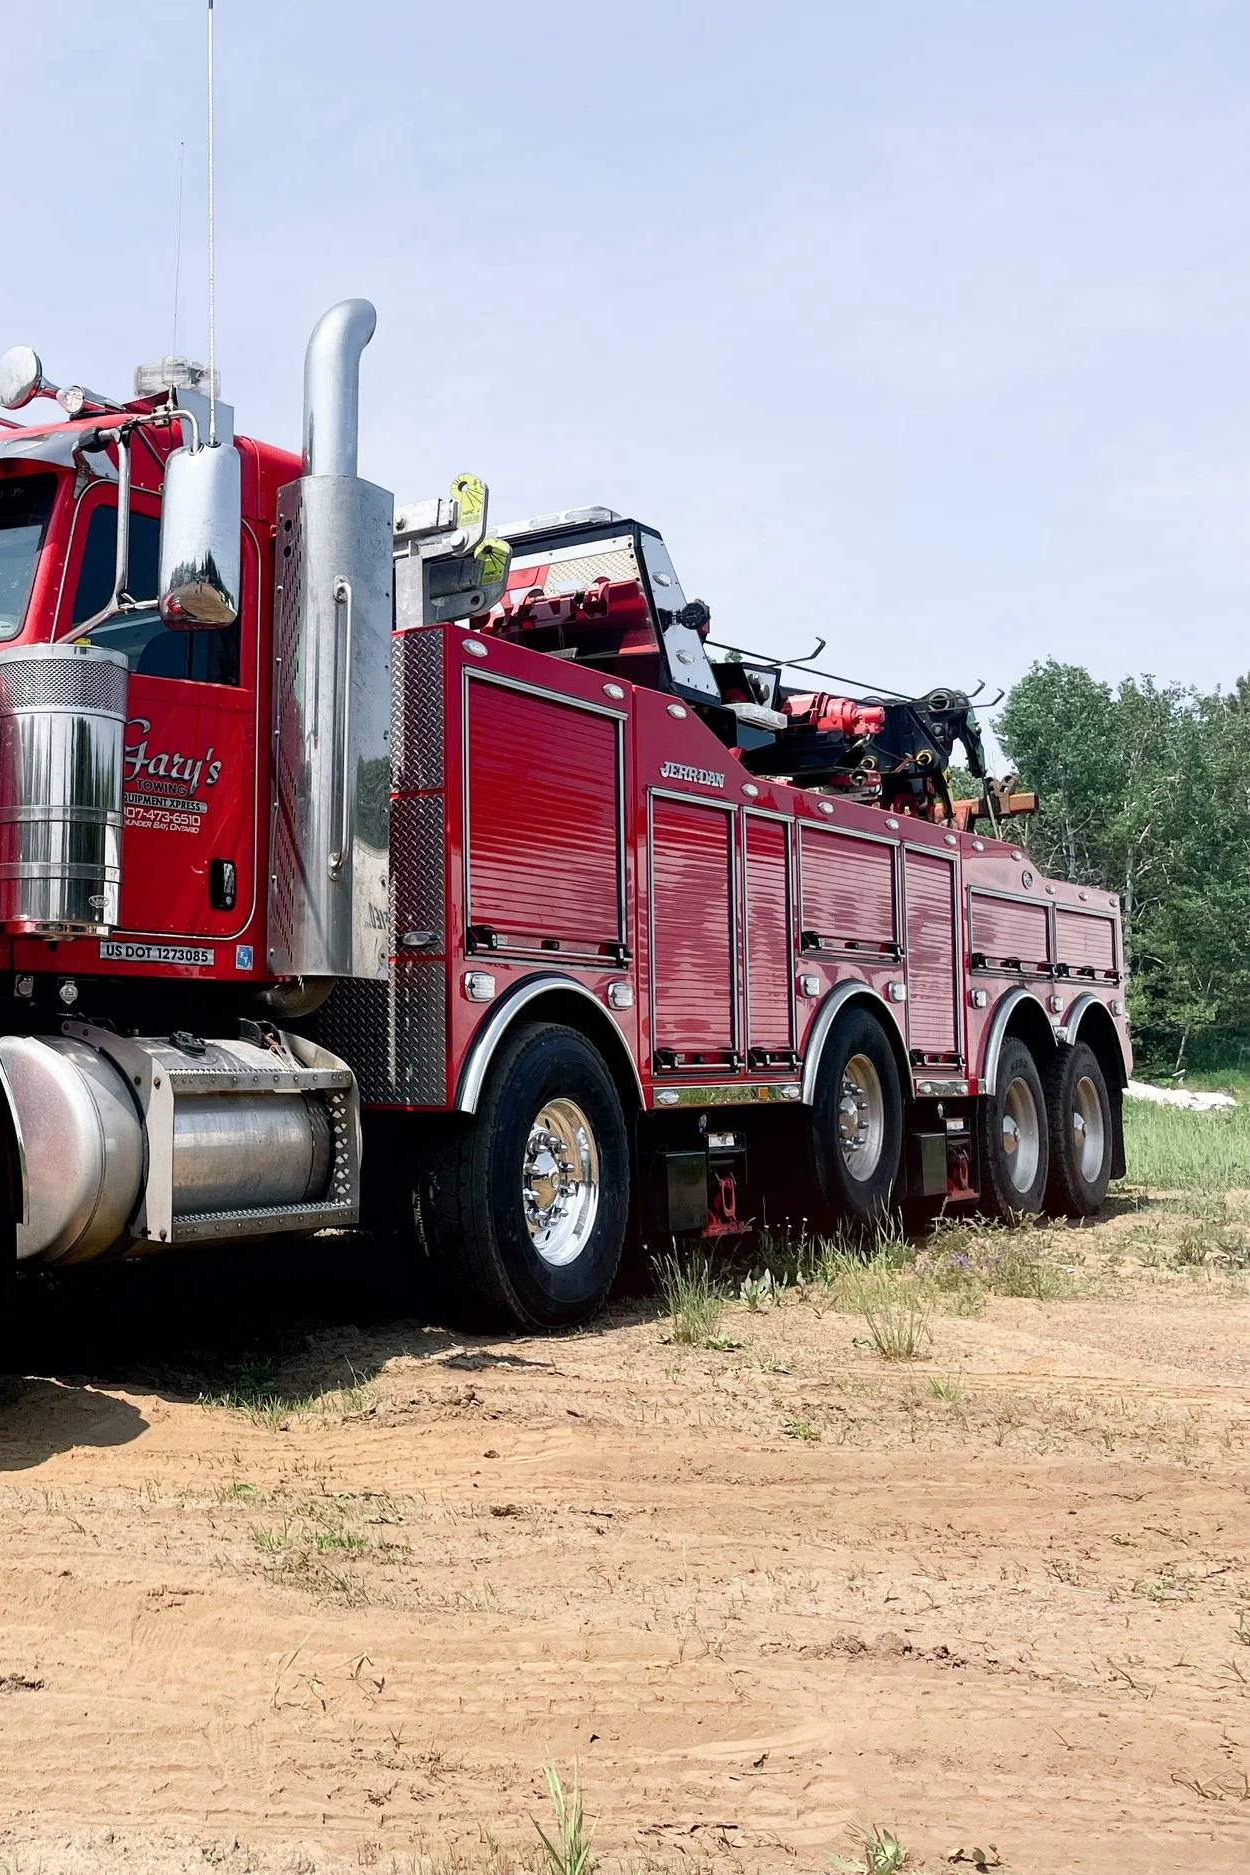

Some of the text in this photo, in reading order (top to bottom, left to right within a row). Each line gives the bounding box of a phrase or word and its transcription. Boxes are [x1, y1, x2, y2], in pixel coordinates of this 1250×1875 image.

[124, 717, 222, 797] Gary's
[136, 779, 187, 797] TOWING
[124, 793, 201, 811] QUIPMENT XPRESS
[123, 807, 201, 826] 07-473-6510
[125, 819, 152, 828] HUNDER
[106, 944, 209, 962] US DOT 1273085
